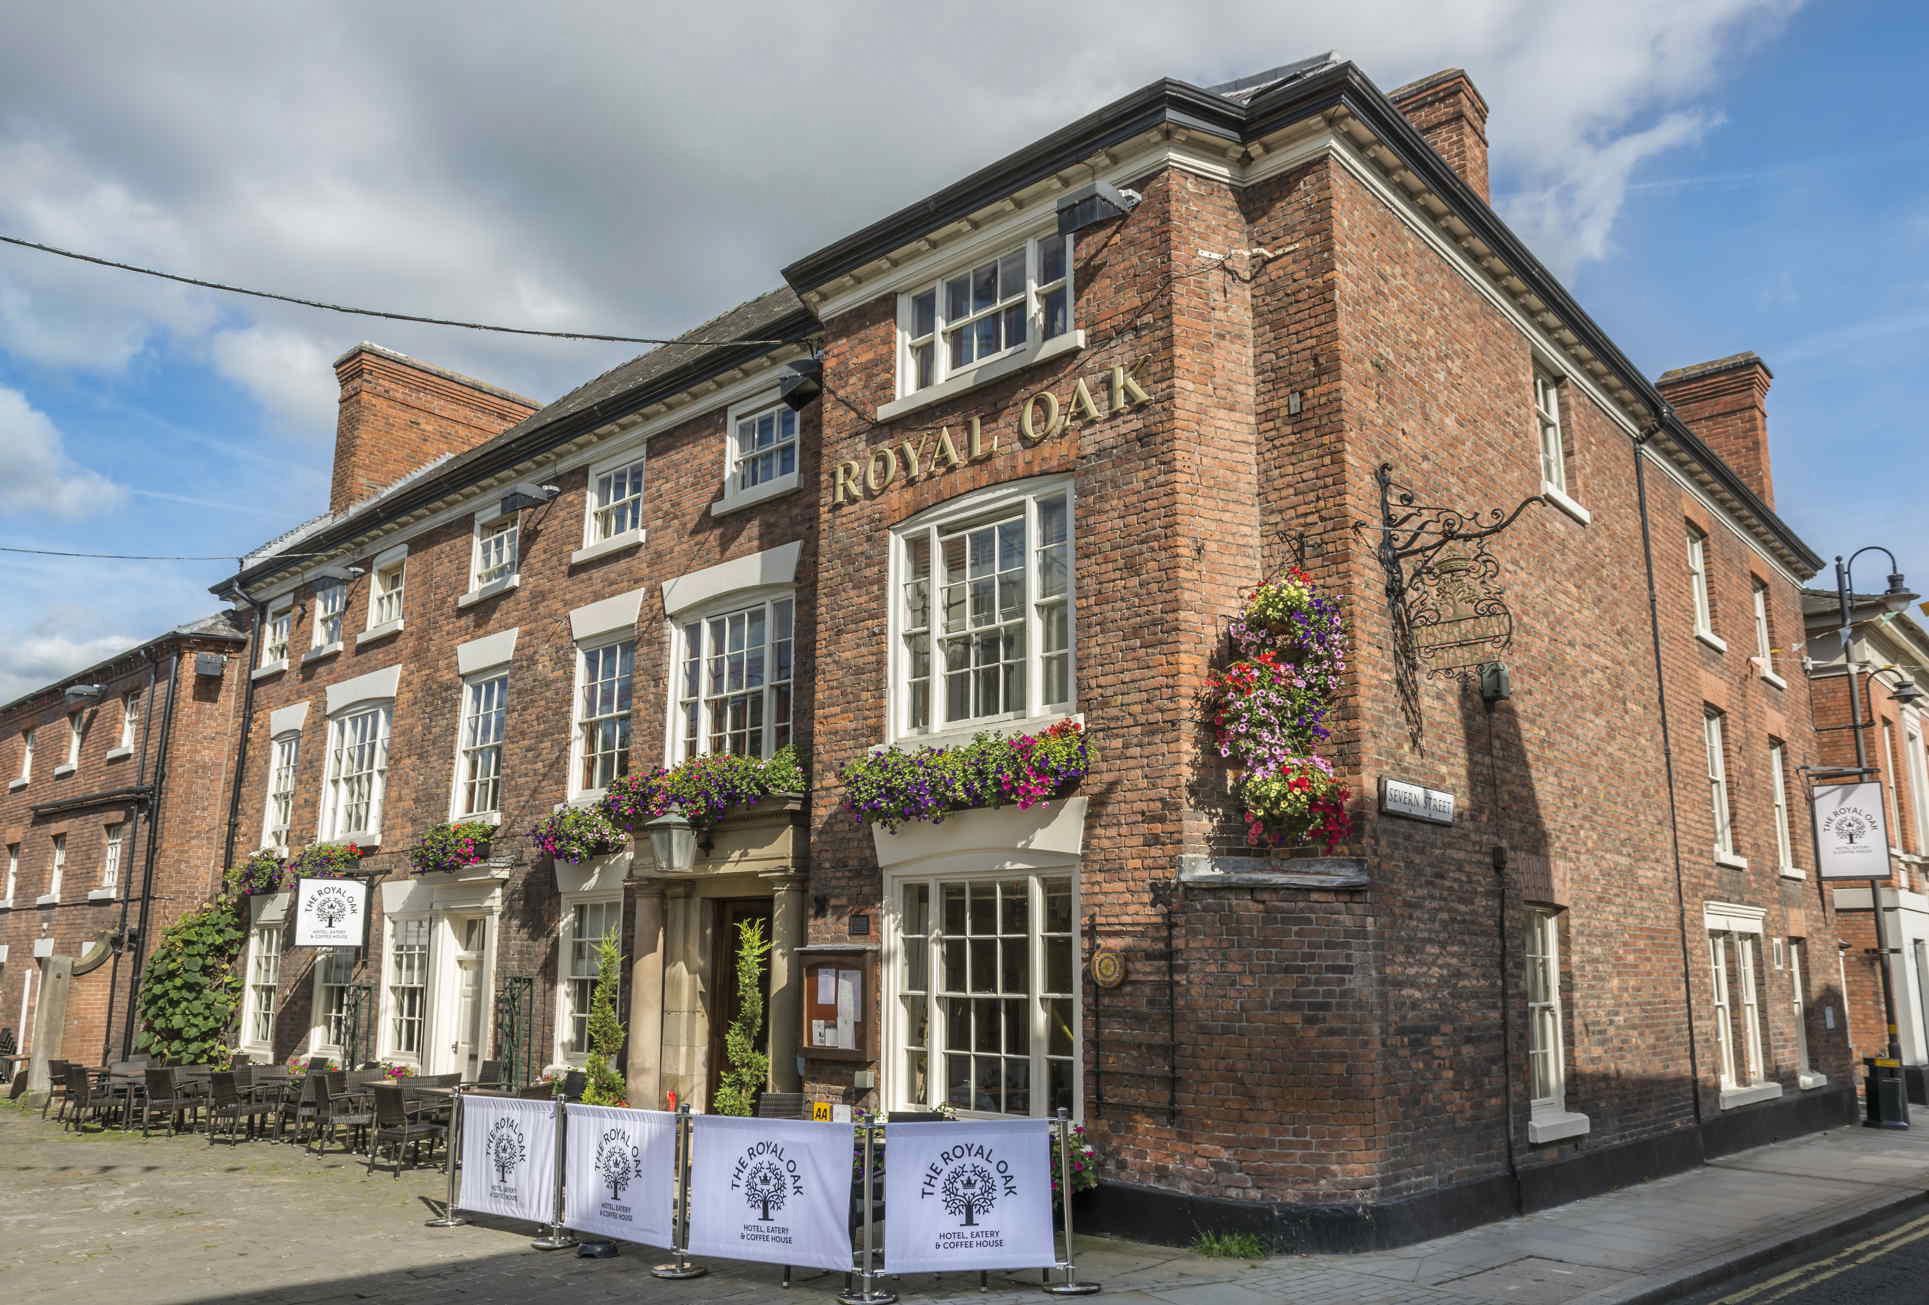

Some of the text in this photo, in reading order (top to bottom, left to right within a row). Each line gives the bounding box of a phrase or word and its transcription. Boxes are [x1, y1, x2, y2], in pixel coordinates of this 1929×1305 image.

[834, 353, 1153, 503] ROYAL OAK
[1388, 788, 1452, 815] SEVERN STREET
[1832, 807, 1864, 817] ROYAL
[304, 886, 358, 914] THE ROYAL OAK
[815, 1107, 828, 1121] AA
[486, 1116, 527, 1163] THE ROYAL OAK
[594, 1127, 643, 1179] THE ROYAL OAK
[731, 1141, 804, 1196] THE ROYAL OAK
[921, 1143, 1018, 1199] THE ROYAL OAK
[746, 1233, 771, 1242] COFFEE
[771, 1235, 793, 1244] HOUSE
[943, 1240, 974, 1249] COFFEE
[975, 1239, 1004, 1248] HOUSE
[970, 1230, 1000, 1239] EATERY
